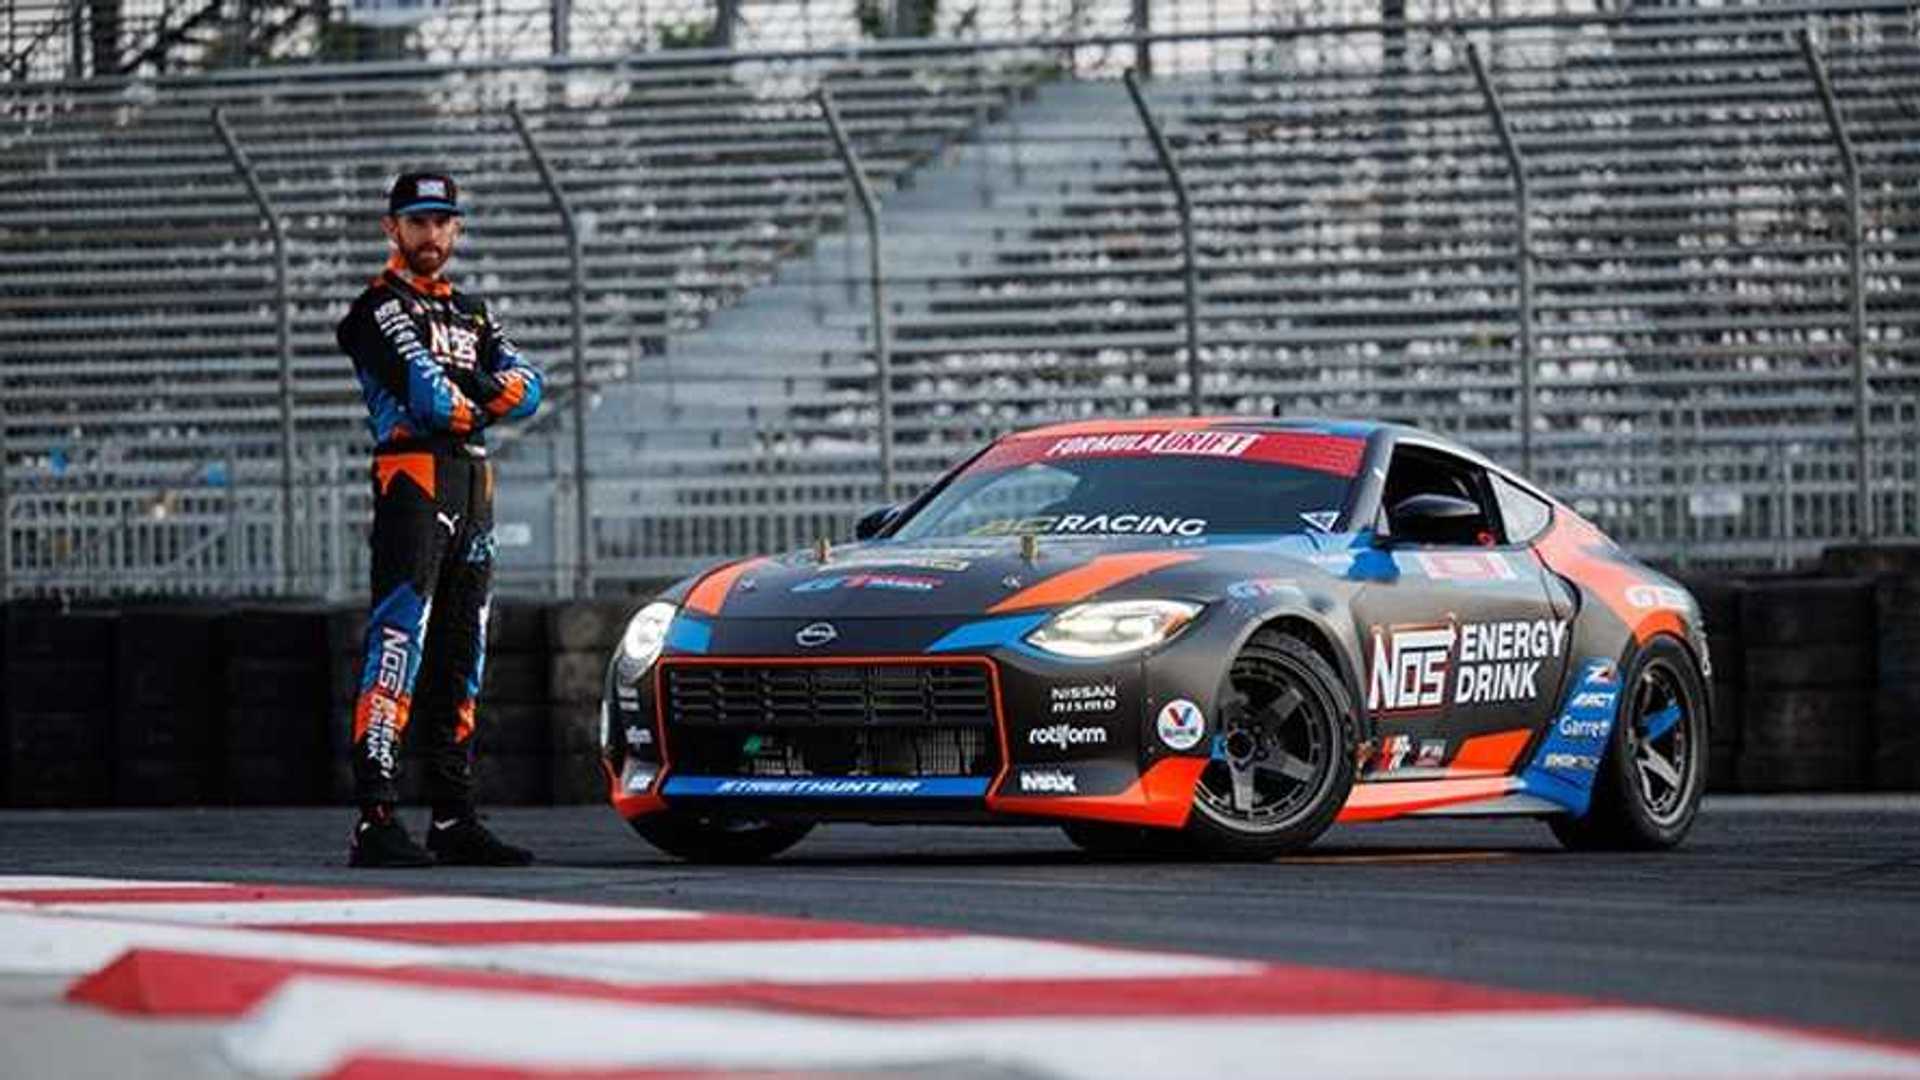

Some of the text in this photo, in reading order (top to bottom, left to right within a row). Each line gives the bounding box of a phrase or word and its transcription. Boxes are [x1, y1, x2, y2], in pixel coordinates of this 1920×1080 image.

[1046, 434, 1160, 457] FORMULA
[1055, 514, 1207, 536] RACING
[379, 626, 409, 698] NOS
[1367, 620, 1566, 711] NOS ENERGY
[1052, 685, 1117, 699] NISSAN
[1455, 662, 1540, 705] DRINK
[1029, 723, 1107, 749] rotiform
